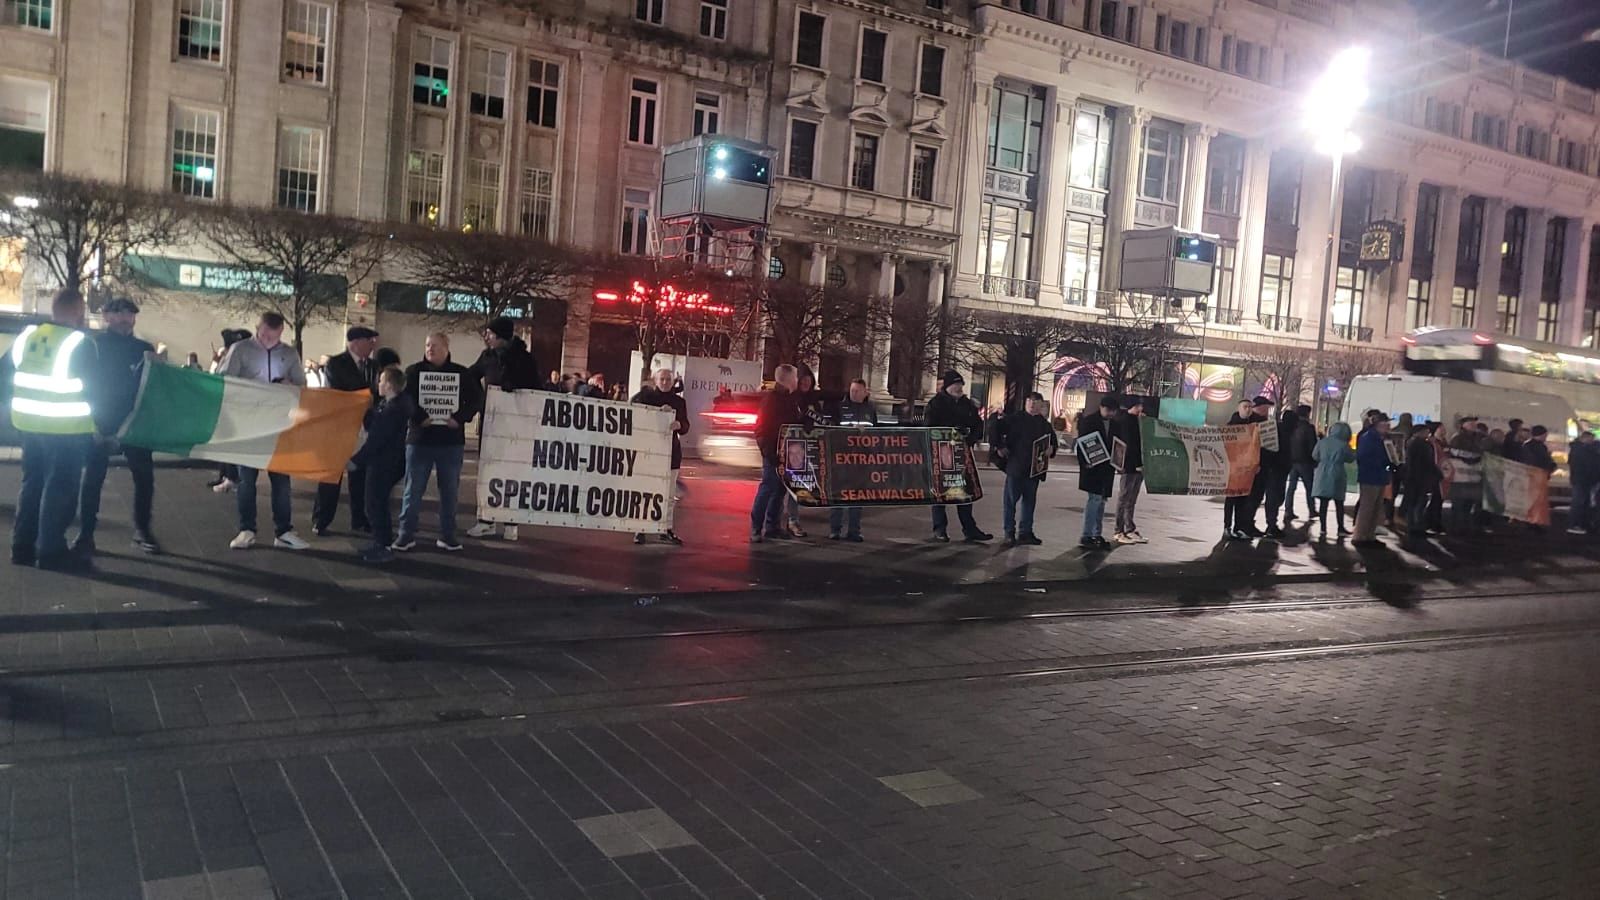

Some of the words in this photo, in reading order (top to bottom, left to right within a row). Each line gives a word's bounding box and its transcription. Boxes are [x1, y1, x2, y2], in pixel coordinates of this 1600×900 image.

[420, 384, 459, 392] NON-JURY
[423, 398, 455, 406] SPECIAL
[541, 398, 633, 436] ABOLISH
[847, 435, 880, 447] STOP
[881, 435, 909, 447] THE
[531, 439, 637, 477] NON-JURY
[834, 453, 923, 465] EXTRADITION
[870, 471, 889, 483] OF
[487, 478, 580, 514] SPECIAL
[586, 486, 664, 521] COURTS
[840, 489, 876, 501] SEAN
[877, 488, 925, 500] WALSH
